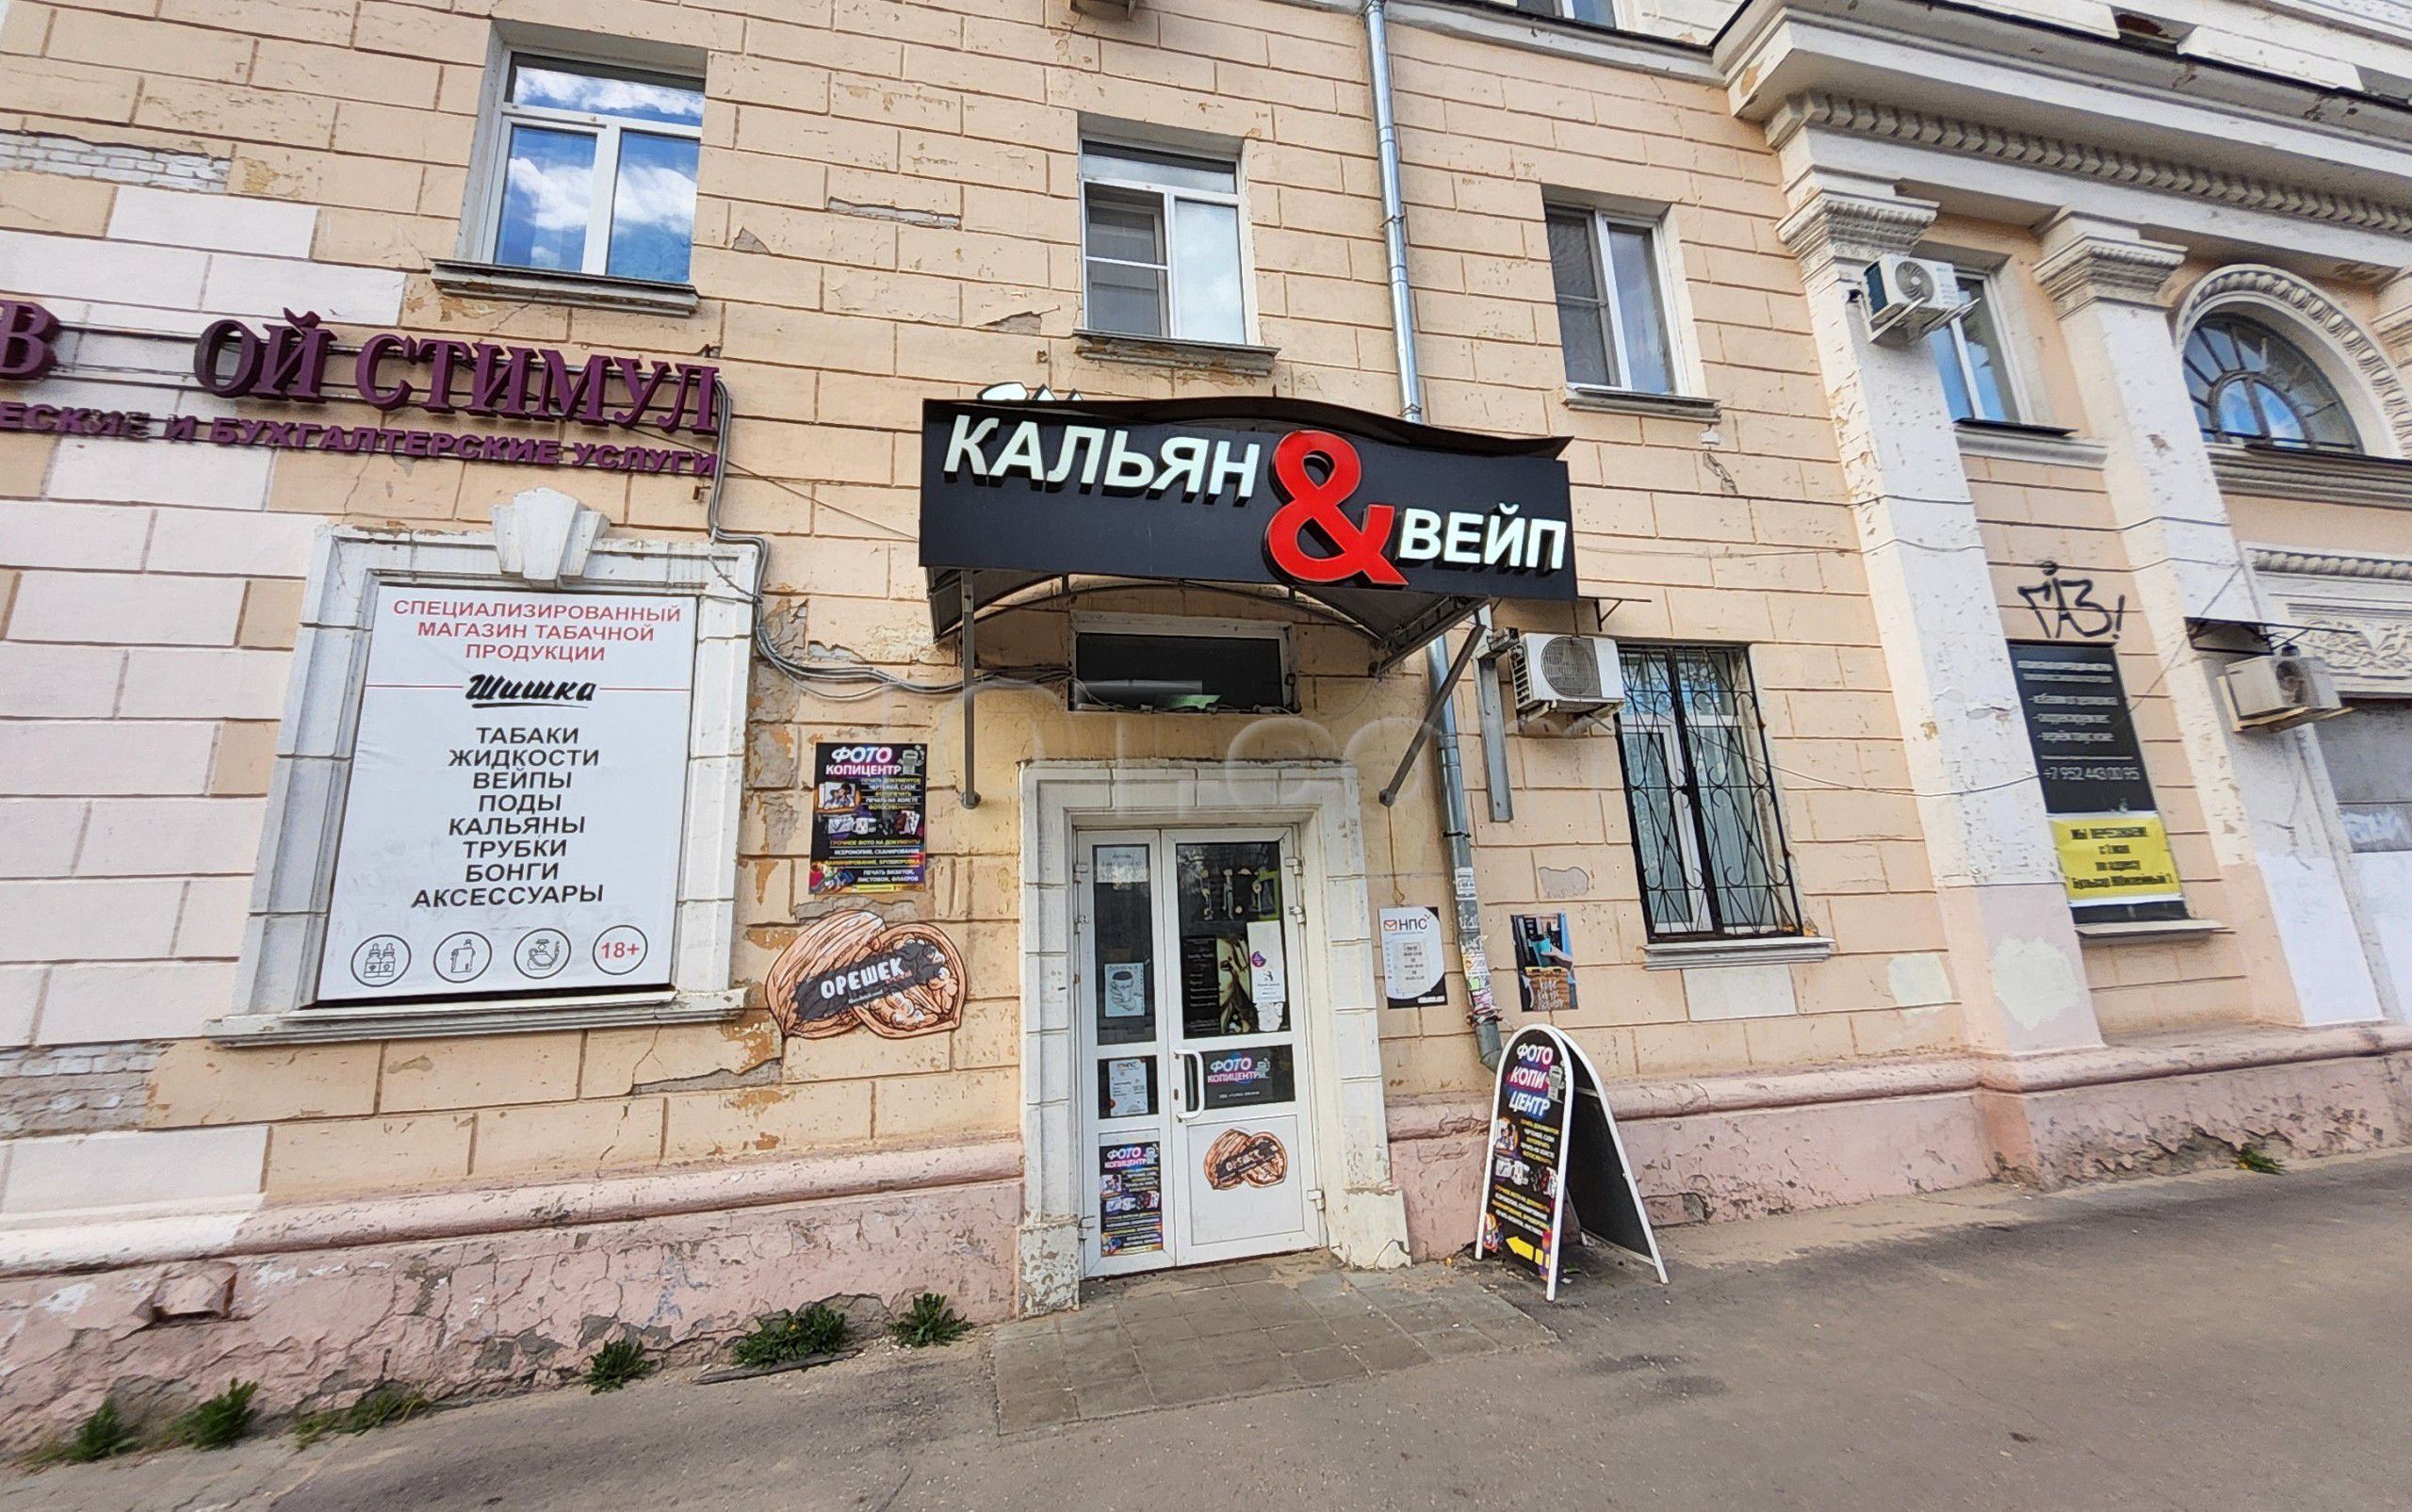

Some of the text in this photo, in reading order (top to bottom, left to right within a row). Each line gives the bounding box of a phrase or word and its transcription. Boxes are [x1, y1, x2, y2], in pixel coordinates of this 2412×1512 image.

[193, 306, 337, 403] ОЙ
[356, 333, 721, 436] СТИМУЛ
[164, 415, 198, 444] И
[209, 416, 562, 465] БУХГАЛТЕРСКИЕ
[571, 442, 719, 477] УСЛУГИ
[942, 415, 1568, 586] КАЛЬЯН & ВЕЙП
[393, 599, 681, 623] СПЕЦИАЛИЗИРОВАННЫЙ
[417, 622, 655, 642] МАГАЗИН ТАБАЧНОЙ
[465, 644, 606, 663] ПРОДУКЦИИ
[465, 674, 597, 703] Шишка
[476, 727, 579, 744] ТАБАКИ
[448, 749, 599, 771] ЖИДКОСТИ
[831, 746, 892, 763] ФОТО
[472, 768, 572, 789] ВЕЙПЫ
[825, 764, 902, 776] КОПИЦЕНТР
[479, 794, 562, 816] ПОДЫ
[448, 817, 585, 836] КАЛЬЯНЫ
[463, 839, 568, 858] ТРУБКИ
[465, 863, 560, 883] БОНГИ
[412, 885, 604, 908] АКСЕССУАРЫ
[1398, 918, 1427, 931] НПС
[600, 941, 640, 959] 18+
[821, 957, 904, 1000] ОРЕШЕК
[1516, 1043, 1554, 1065] ФОТО
[1210, 1057, 1252, 1073] ФОТО
[1207, 1071, 1260, 1082] КОПИЦЕНТР
[1509, 1065, 1547, 1089] КОПИ
[1508, 1090, 1551, 1116] ЦЕНТР
[1106, 1146, 1142, 1160] ФОТО
